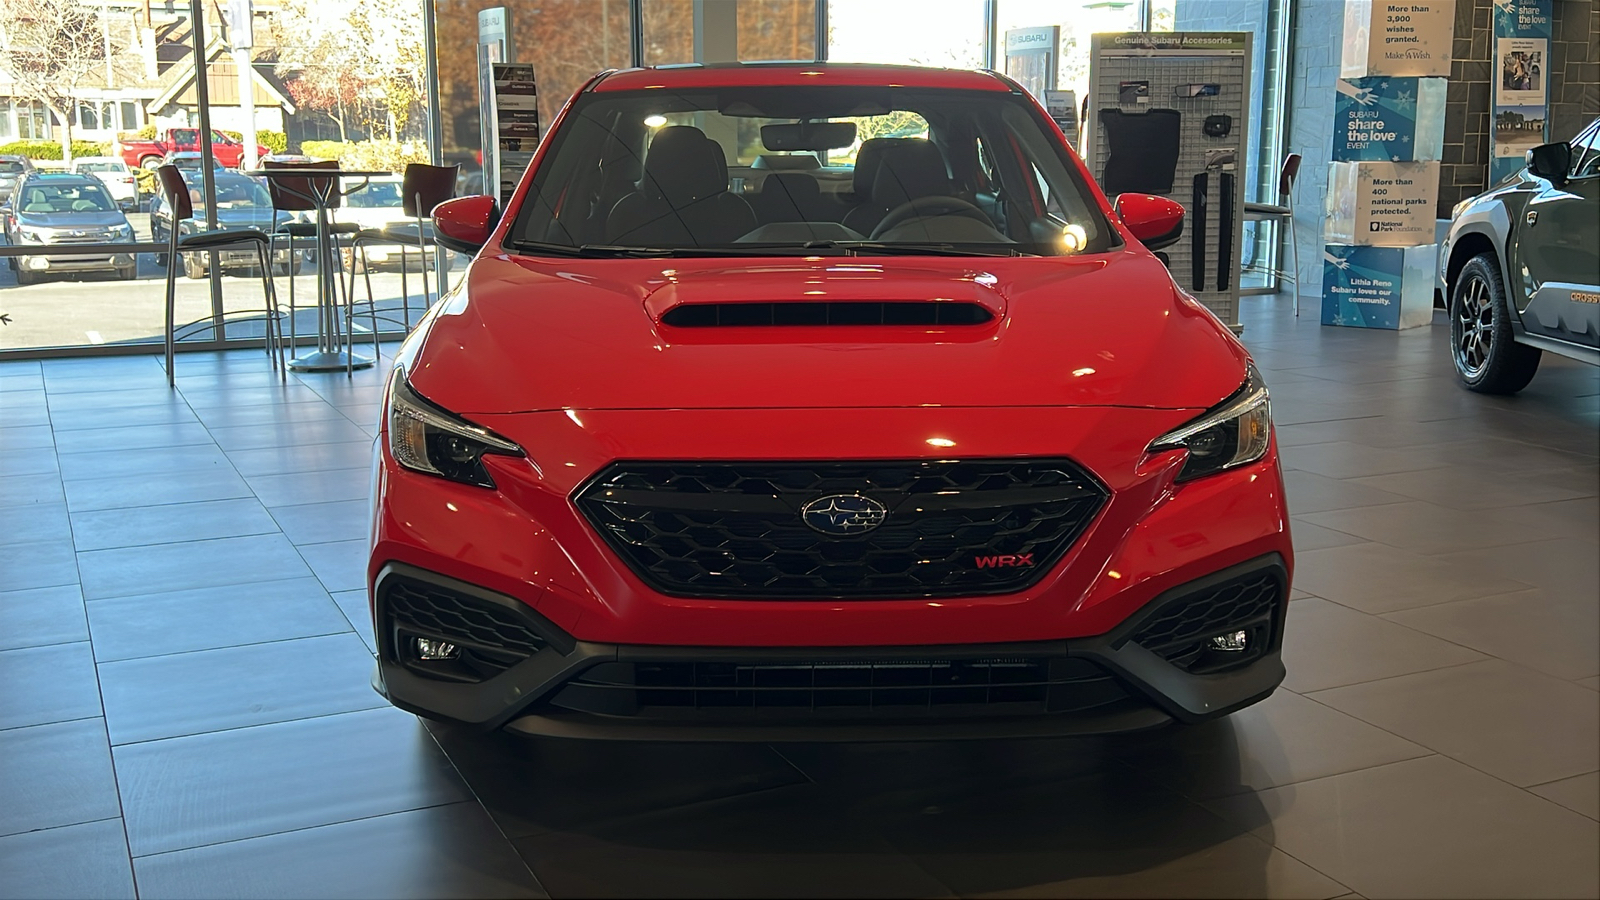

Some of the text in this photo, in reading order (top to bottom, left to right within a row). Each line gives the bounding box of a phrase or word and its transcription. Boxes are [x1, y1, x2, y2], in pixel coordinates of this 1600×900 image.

[1518, 6, 1540, 14] share
[1387, 15, 1411, 23] 3,900
[1518, 15, 1547, 24] the love
[1017, 33, 1048, 43] SUBARU
[1114, 36, 1149, 44] Genuine
[1151, 36, 1180, 44] Subaru
[1385, 36, 1420, 44] granted.
[1348, 110, 1379, 119] SUBARU
[1348, 118, 1385, 130] share
[1347, 130, 1397, 142] the love
[1346, 141, 1370, 150] EVENT
[1372, 178, 1413, 186] More than
[1372, 188, 1388, 196] 400
[1405, 198, 1427, 206] parks
[1371, 208, 1412, 216] protected.
[1350, 278, 1393, 287] Lithia Reno
[1331, 286, 1357, 294] Subaru
[1358, 287, 1377, 295] loves
[1348, 297, 1391, 306] community.
[974, 552, 1034, 569] WRX
